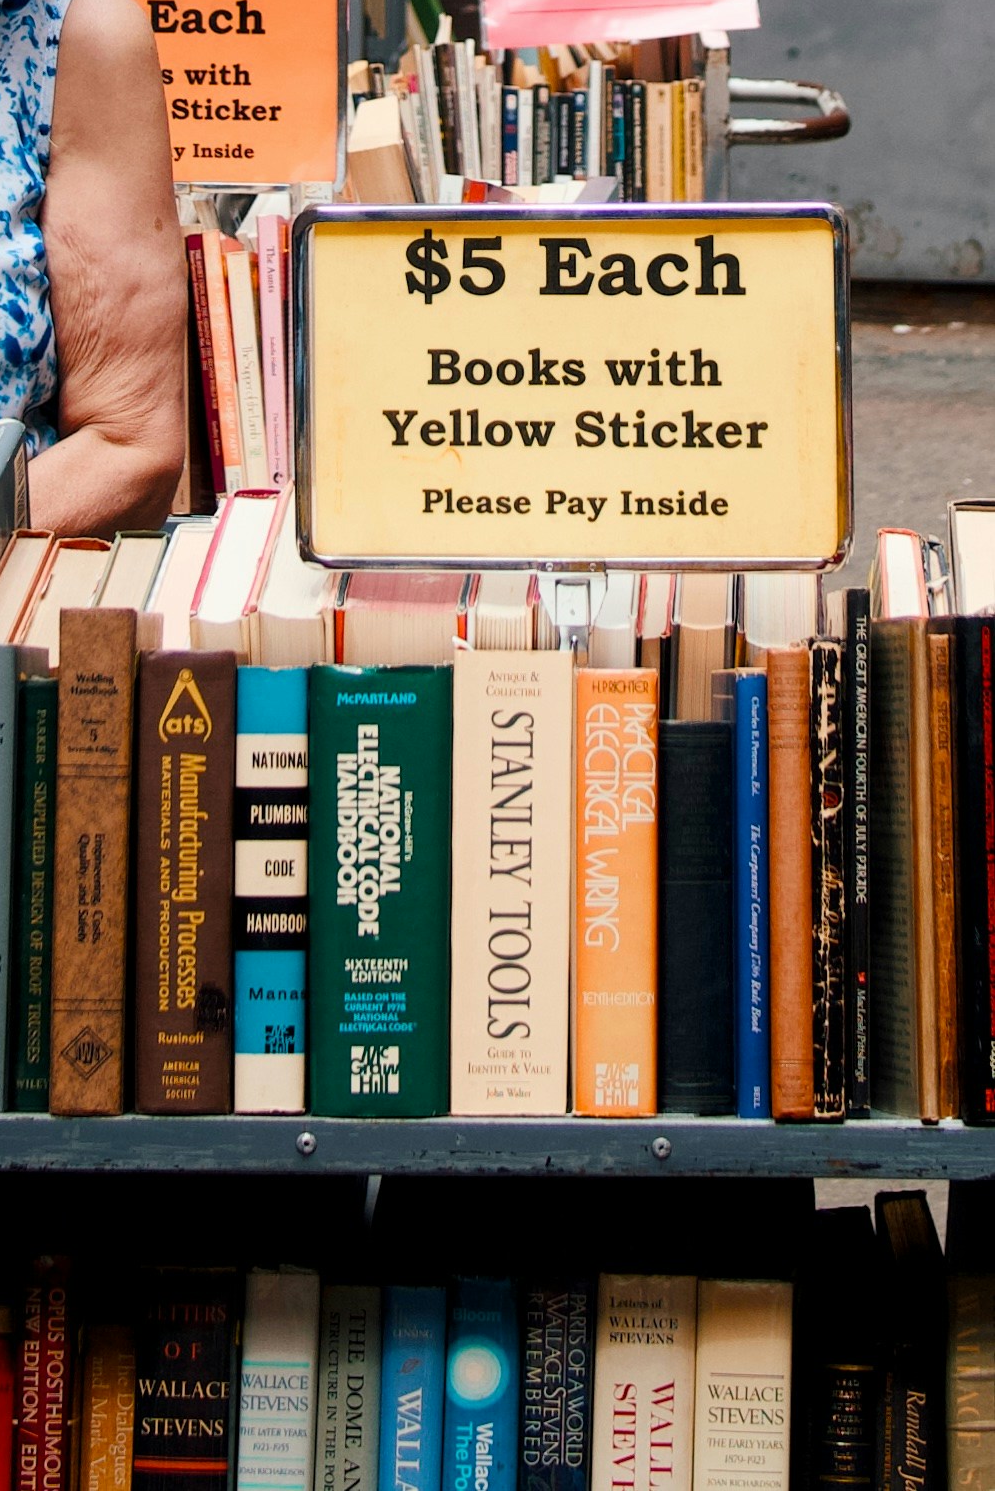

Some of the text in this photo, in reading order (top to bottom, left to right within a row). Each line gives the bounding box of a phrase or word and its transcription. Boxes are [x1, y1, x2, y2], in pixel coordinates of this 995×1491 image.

[147, 0, 266, 34] Each
[184, 63, 252, 86] with
[172, 98, 282, 121] Sticker
[193, 143, 255, 159] Inside
[266, 246, 276, 293] The Aunts
[405, 229, 746, 305] $5 Each
[427, 348, 723, 387] Books with
[383, 409, 768, 449] Yellow Sticker
[422, 489, 730, 523] Please Pay Inside
[165, 716, 205, 735] ats
[252, 751, 308, 770] NATIONAL
[622, 703, 656, 832] PRACTICAL
[855, 615, 867, 905] THE GREAT AMERICAN FOURTH OF JULY PARADE
[336, 753, 358, 905] HANDBOOK
[357, 724, 380, 937] ELECTRICAL CODE
[379, 765, 401, 896] NATIONAL
[584, 703, 621, 953] ELECTRICAL WIRING
[749, 824, 761, 843] The
[158, 755, 172, 1012] MATERIALS AND PRODUCTION
[171, 753, 208, 1010] Manufacturing Processes
[265, 860, 296, 878] CODE
[487, 710, 535, 1040] STANLEY TOOLS
[27, 781, 47, 1064] SIMPLIFIED DESIGN OF ROOF TRUSSES
[747, 903, 761, 951] Company
[344, 958, 408, 971] SIXTEENTH
[351, 971, 402, 983] EDITION
[749, 1006, 762, 1033] Book
[158, 1031, 205, 1045] Rusinoff
[753, 1086, 761, 1109] BELL
[47, 1288, 66, 1342] OPUS
[453, 1307, 502, 1323] Bloom
[649, 1296, 664, 1310] of
[609, 1315, 679, 1331] WALLACE
[609, 1330, 675, 1346] STEVENS
[21, 1287, 40, 1424] NEW EDITION
[162, 1340, 202, 1362] OF
[138, 1378, 230, 1400] WALLACE
[240, 1373, 310, 1390] WALLACE
[344, 1309, 366, 1449] THE DOME
[524, 1293, 544, 1467] REMEMBERED
[542, 1293, 567, 1466] WALLACE STEVENS
[565, 1293, 587, 1467] PARTS OF A WORLD
[707, 1384, 785, 1403] WALLACE
[239, 1394, 309, 1412] STEVENS
[707, 1406, 785, 1426] STEVENS
[90, 1396, 108, 1449] Mark
[108, 1392, 134, 1485] Dialogues
[140, 1417, 224, 1438] STEVENS
[904, 1388, 927, 1471] Randall
